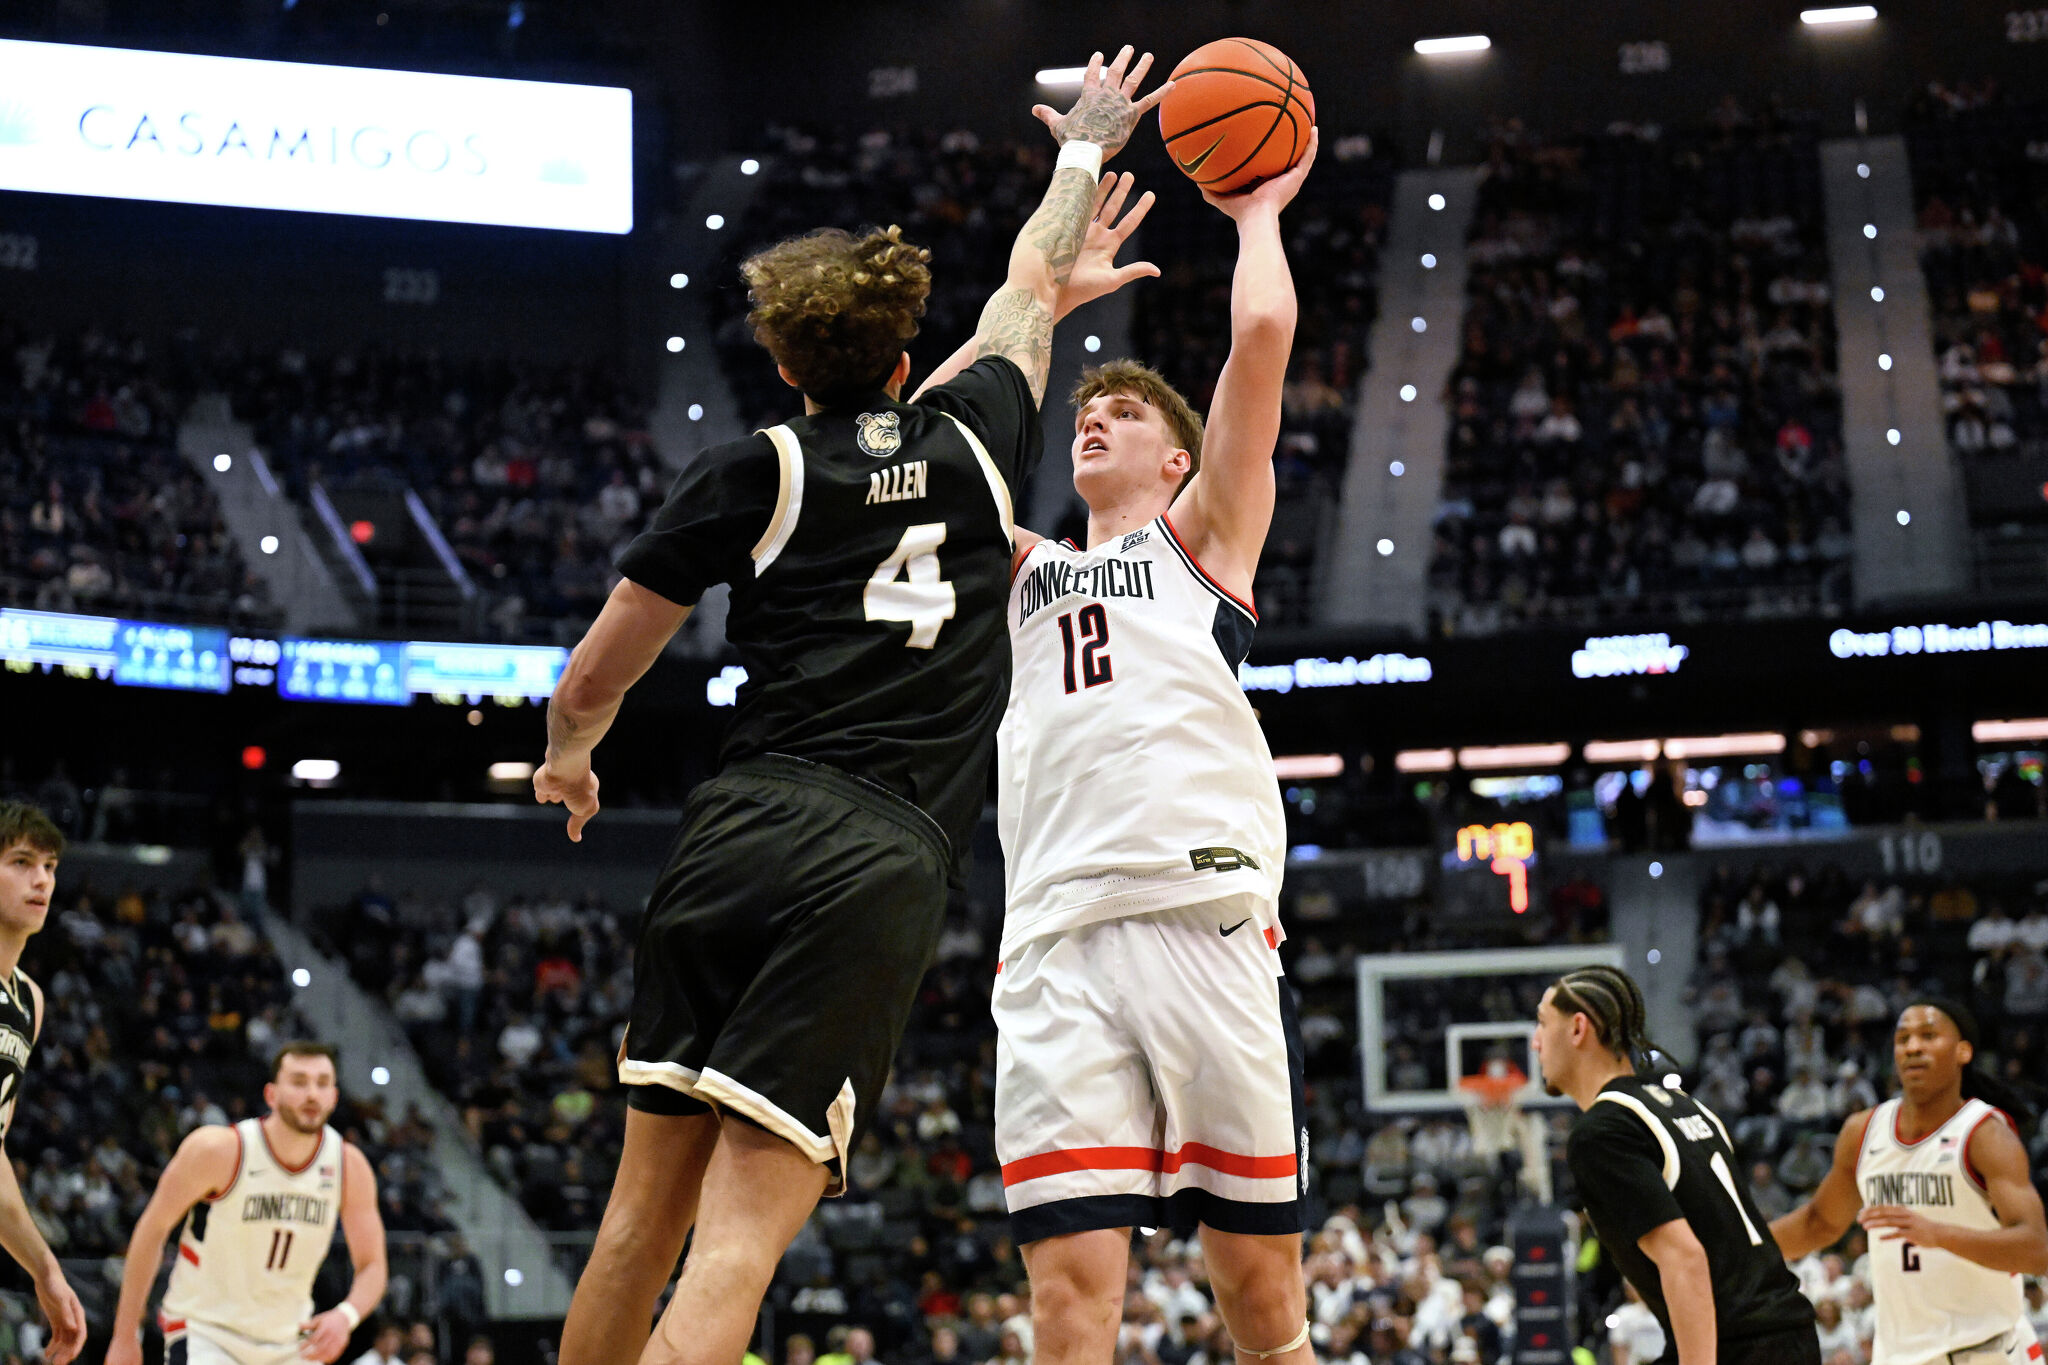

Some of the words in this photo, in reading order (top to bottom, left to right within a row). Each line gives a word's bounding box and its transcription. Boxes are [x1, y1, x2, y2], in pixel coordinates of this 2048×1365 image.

[79, 104, 488, 177] CASAMIGOS
[865, 460, 927, 505] ALLEN
[1121, 533, 1150, 550] EAST
[1124, 529, 1144, 542] BIG
[863, 522, 956, 650] 4
[1019, 559, 1154, 628] CONNECTICUT
[1058, 603, 1113, 694] 12
[1879, 832, 1941, 873] 110
[242, 1193, 329, 1226] CONNECTICUT
[1710, 1151, 1763, 1246] 1
[1866, 1172, 1954, 1207] CONNECTICUT
[266, 1228, 294, 1270] 11
